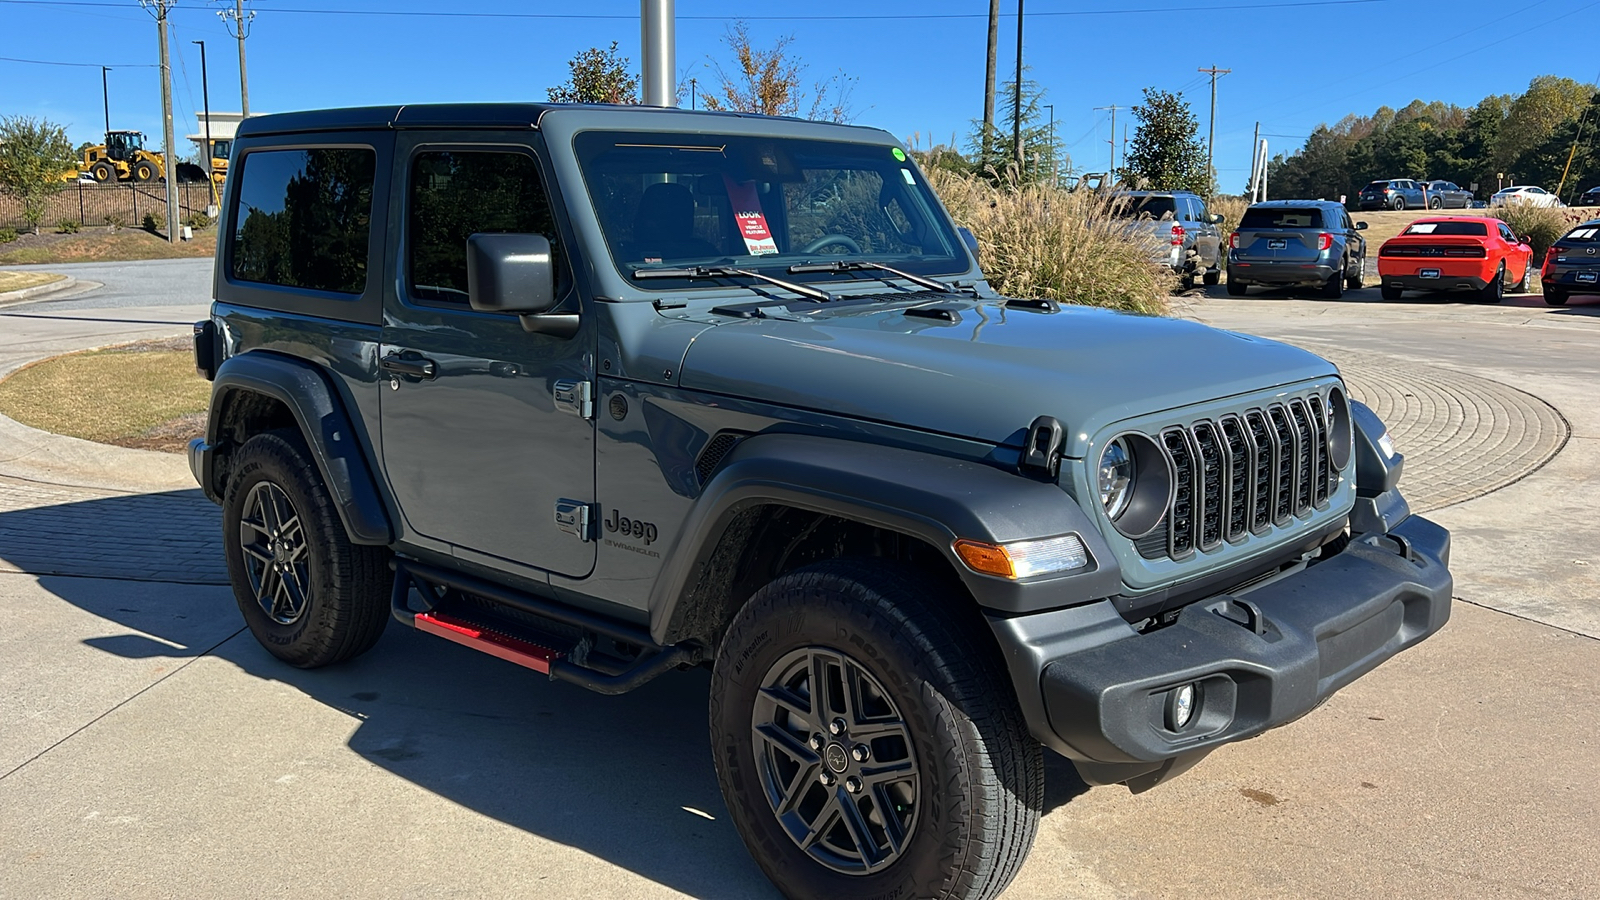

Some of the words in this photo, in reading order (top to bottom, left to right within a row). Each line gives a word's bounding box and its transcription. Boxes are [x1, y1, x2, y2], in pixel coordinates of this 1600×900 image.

[738, 211, 761, 219] LOOK
[229, 461, 260, 502] NEXEN
[605, 509, 658, 546] Jeep
[612, 541, 660, 559] WRANGLER
[735, 630, 769, 675] All-Weather
